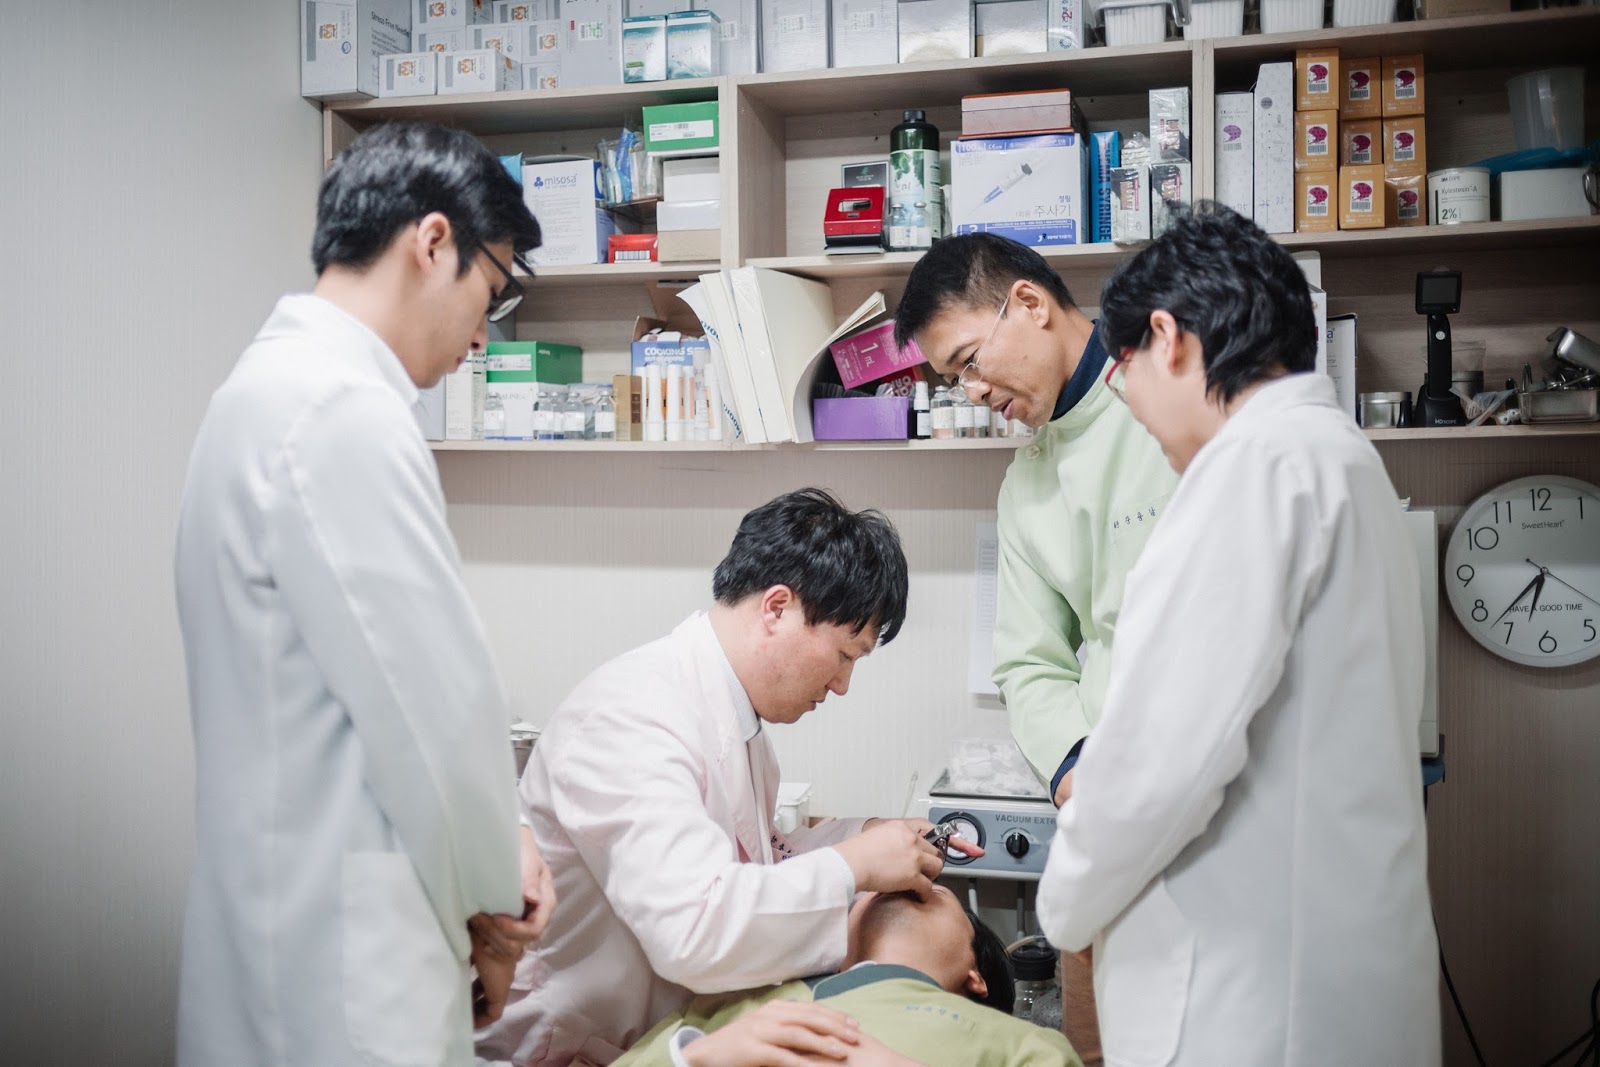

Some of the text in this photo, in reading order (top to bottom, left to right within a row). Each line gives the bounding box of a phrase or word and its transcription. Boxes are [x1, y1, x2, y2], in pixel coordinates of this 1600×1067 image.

[545, 176, 577, 185] misosa
[1033, 204, 1071, 218] 주사기
[1098, 187, 1111, 242] SYRINGE
[1441, 207, 1458, 220] 2%
[644, 347, 686, 356] COOKING
[1529, 488, 1553, 512] 12
[1577, 496, 1584, 520] 1
[1492, 501, 1512, 524] 11
[1521, 520, 1564, 530] SweetHeart
[1467, 526, 1499, 551] 10
[1456, 564, 1475, 588] 9
[1471, 599, 1488, 623] 8
[1539, 604, 1563, 612] GOOD
[1565, 603, 1583, 611] TIME
[1504, 621, 1514, 645] 7
[1538, 630, 1557, 653] 6
[1583, 619, 1596, 642] 5
[995, 814, 1031, 823] VACUUM
